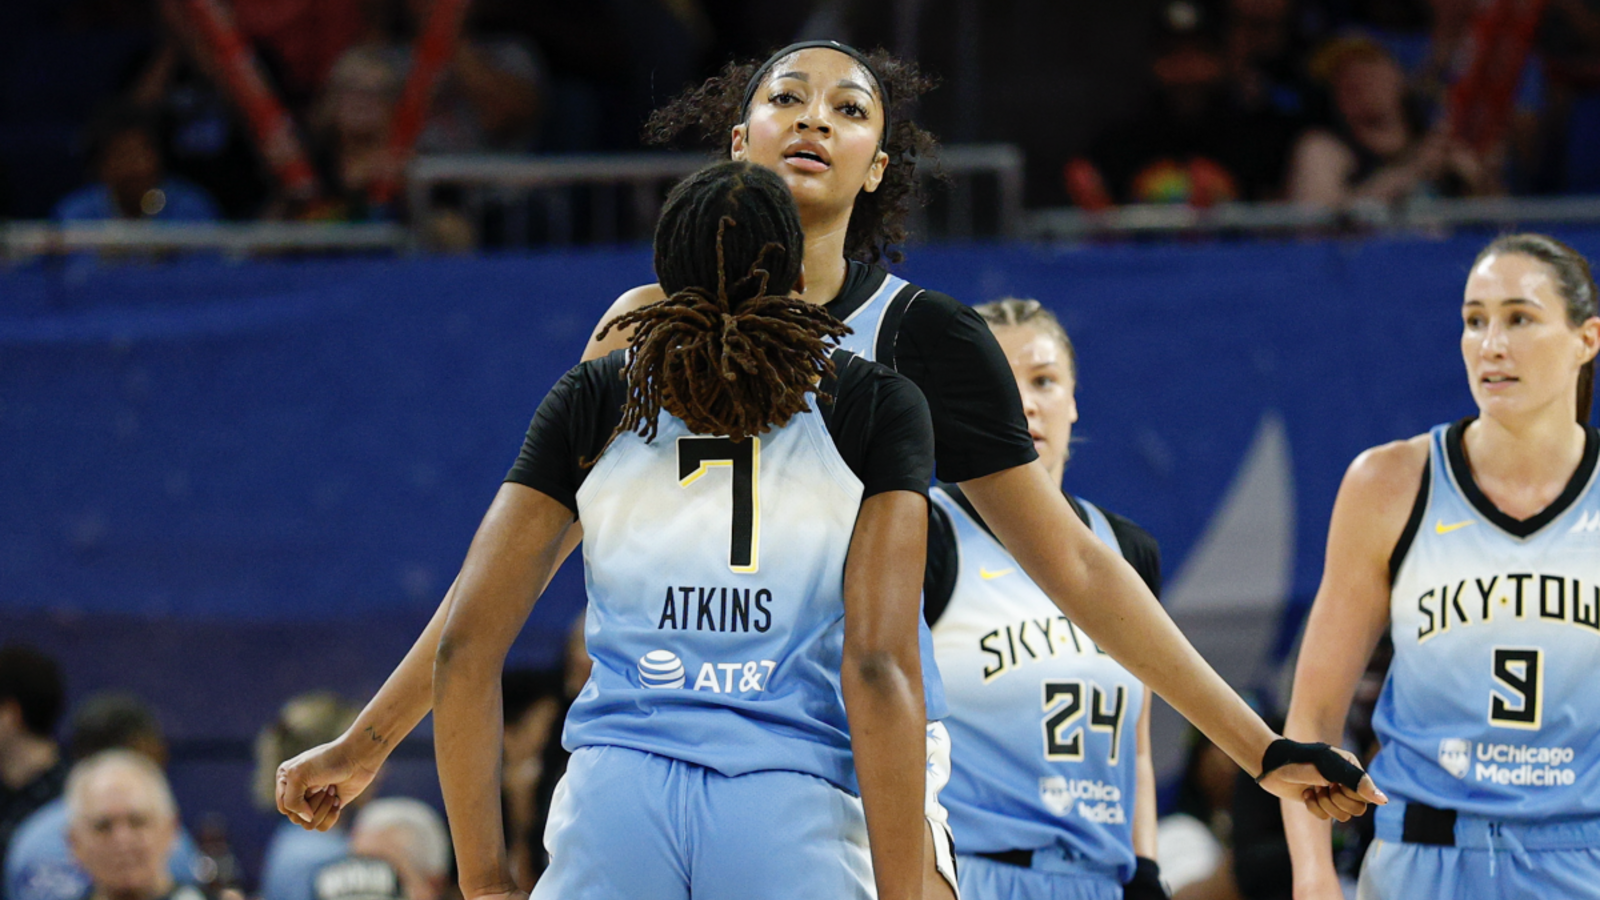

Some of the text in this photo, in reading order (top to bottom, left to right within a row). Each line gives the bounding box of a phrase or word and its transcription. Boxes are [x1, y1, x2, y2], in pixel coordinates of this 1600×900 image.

[676, 435, 760, 573] 7
[657, 585, 773, 633] ATKINS
[692, 659, 777, 694] AT&T
[1488, 645, 1544, 731] 9
[1042, 679, 1128, 766] 24
[1475, 762, 1576, 786] Medicine
[1476, 742, 1575, 767] UChicago
